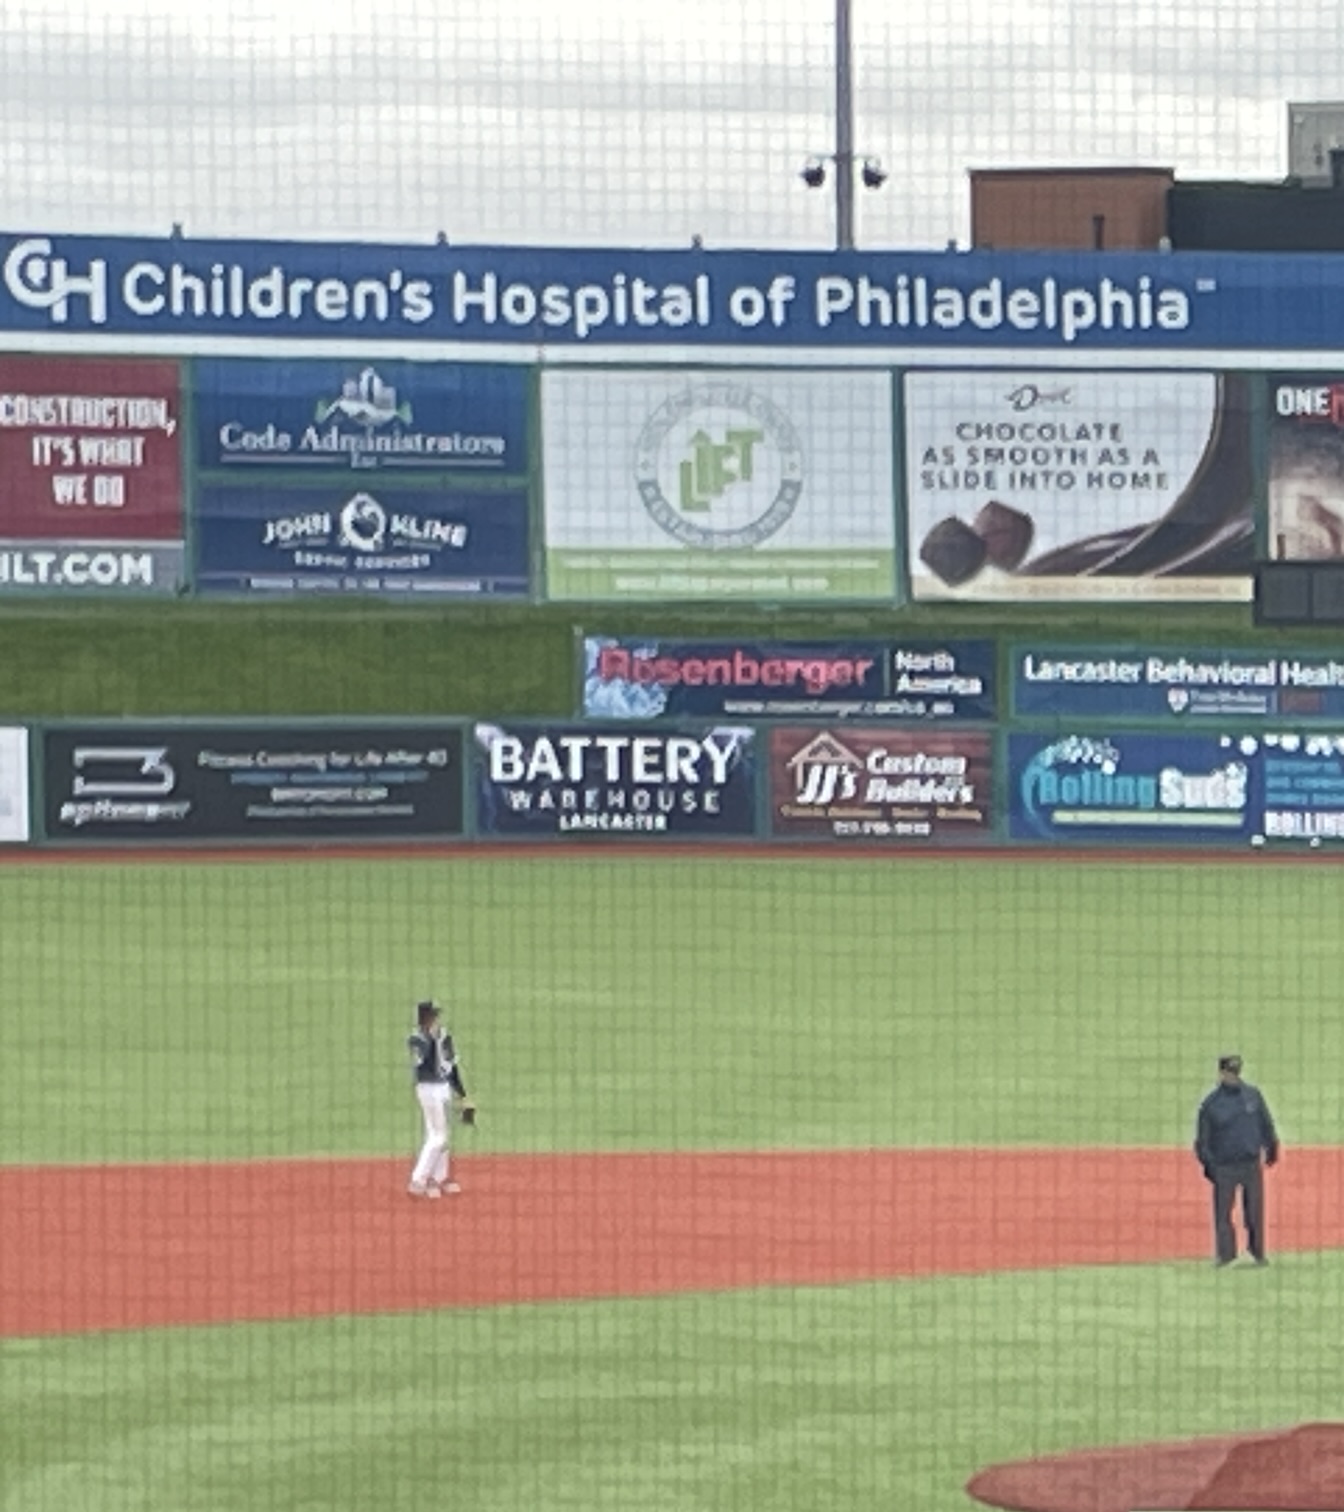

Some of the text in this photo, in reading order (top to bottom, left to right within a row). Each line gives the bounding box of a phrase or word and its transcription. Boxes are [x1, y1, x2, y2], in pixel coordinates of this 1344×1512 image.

[122, 261, 434, 322] Children's
[453, 271, 711, 338] Hospital
[729, 275, 796, 327] of
[815, 275, 1190, 341] Philadelphia
[0, 394, 176, 437] CONSTRUCTION,
[218, 420, 507, 455] Code Administrators
[955, 422, 1123, 443] CHOCOLATE
[32, 435, 146, 467] IT'S WHAT
[922, 447, 1161, 467] AS SMOOTH AS A
[52, 474, 125, 508] WE DO
[920, 470, 1169, 491] SLIDE INTO HOME
[262, 511, 332, 545] JOHN
[389, 513, 469, 549] KLINE
[599, 650, 874, 694] Rosenberger
[1023, 656, 1141, 683] Lancaster
[1146, 658, 1276, 687] Behavioral
[489, 734, 737, 784] BATTERY
[867, 747, 967, 775] Custom
[511, 789, 721, 814] WAREHOUSE
[1039, 768, 1157, 808] Rolling
[559, 813, 669, 831] LANCASTER
